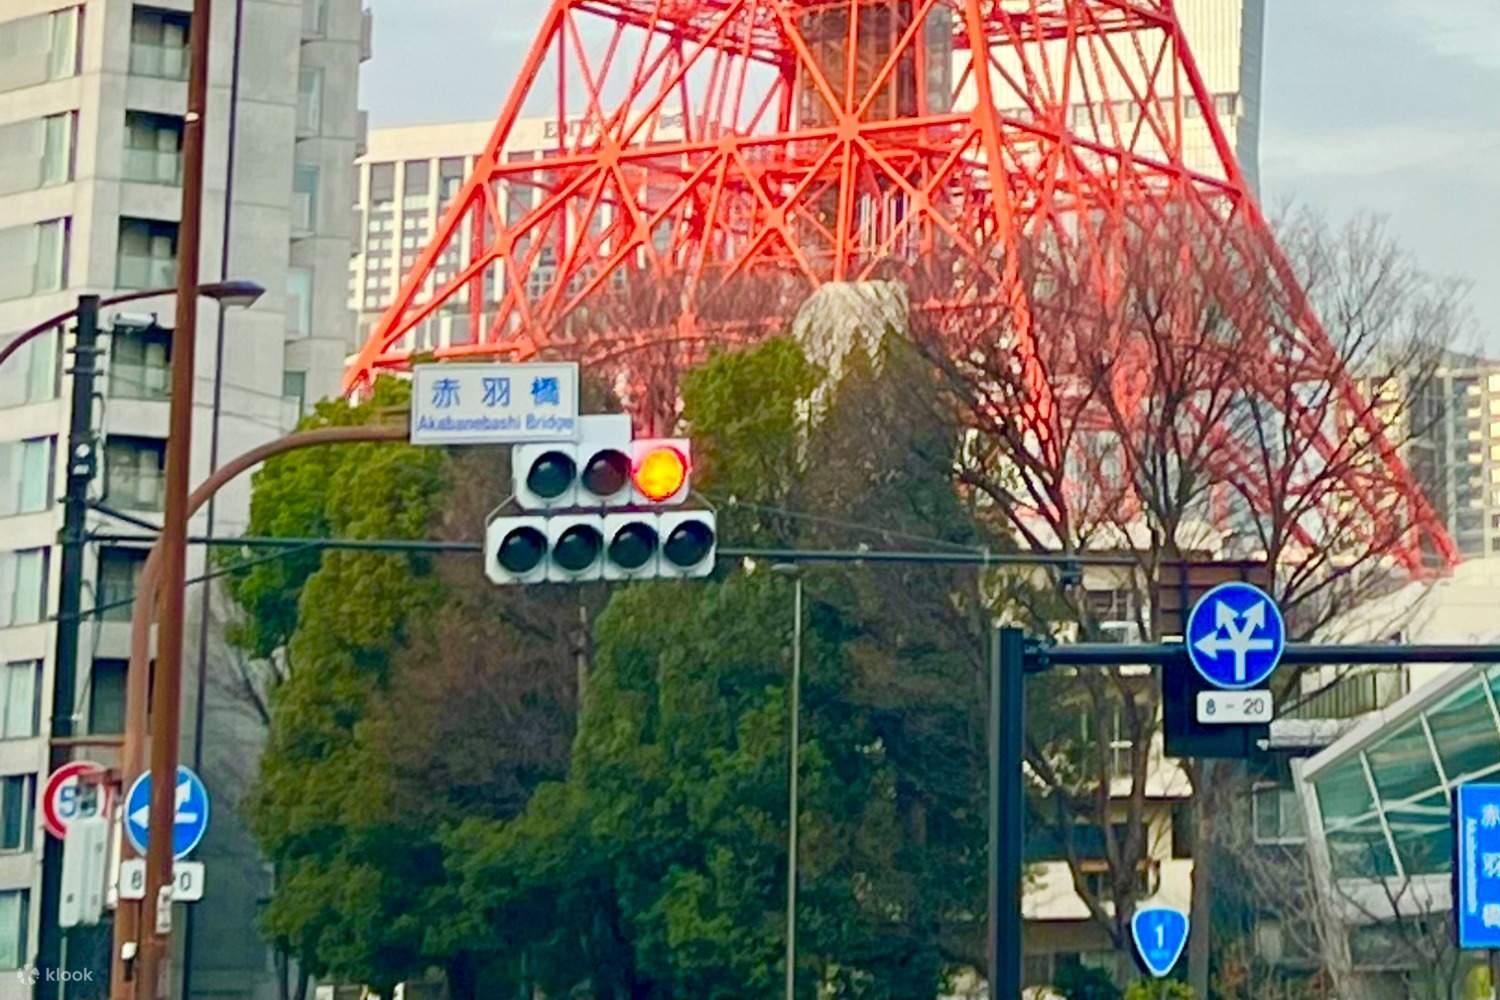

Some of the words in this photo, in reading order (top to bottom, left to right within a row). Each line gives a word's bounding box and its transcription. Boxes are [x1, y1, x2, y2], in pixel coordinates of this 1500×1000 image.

[431, 376, 559, 409] 赤羽橋
[417, 415, 521, 431] Akabanebashi
[526, 414, 574, 433] Bridge
[1206, 699, 1216, 715] 8
[1243, 698, 1264, 715] 20
[131, 870, 143, 890] 8
[1154, 924, 1164, 949] 1
